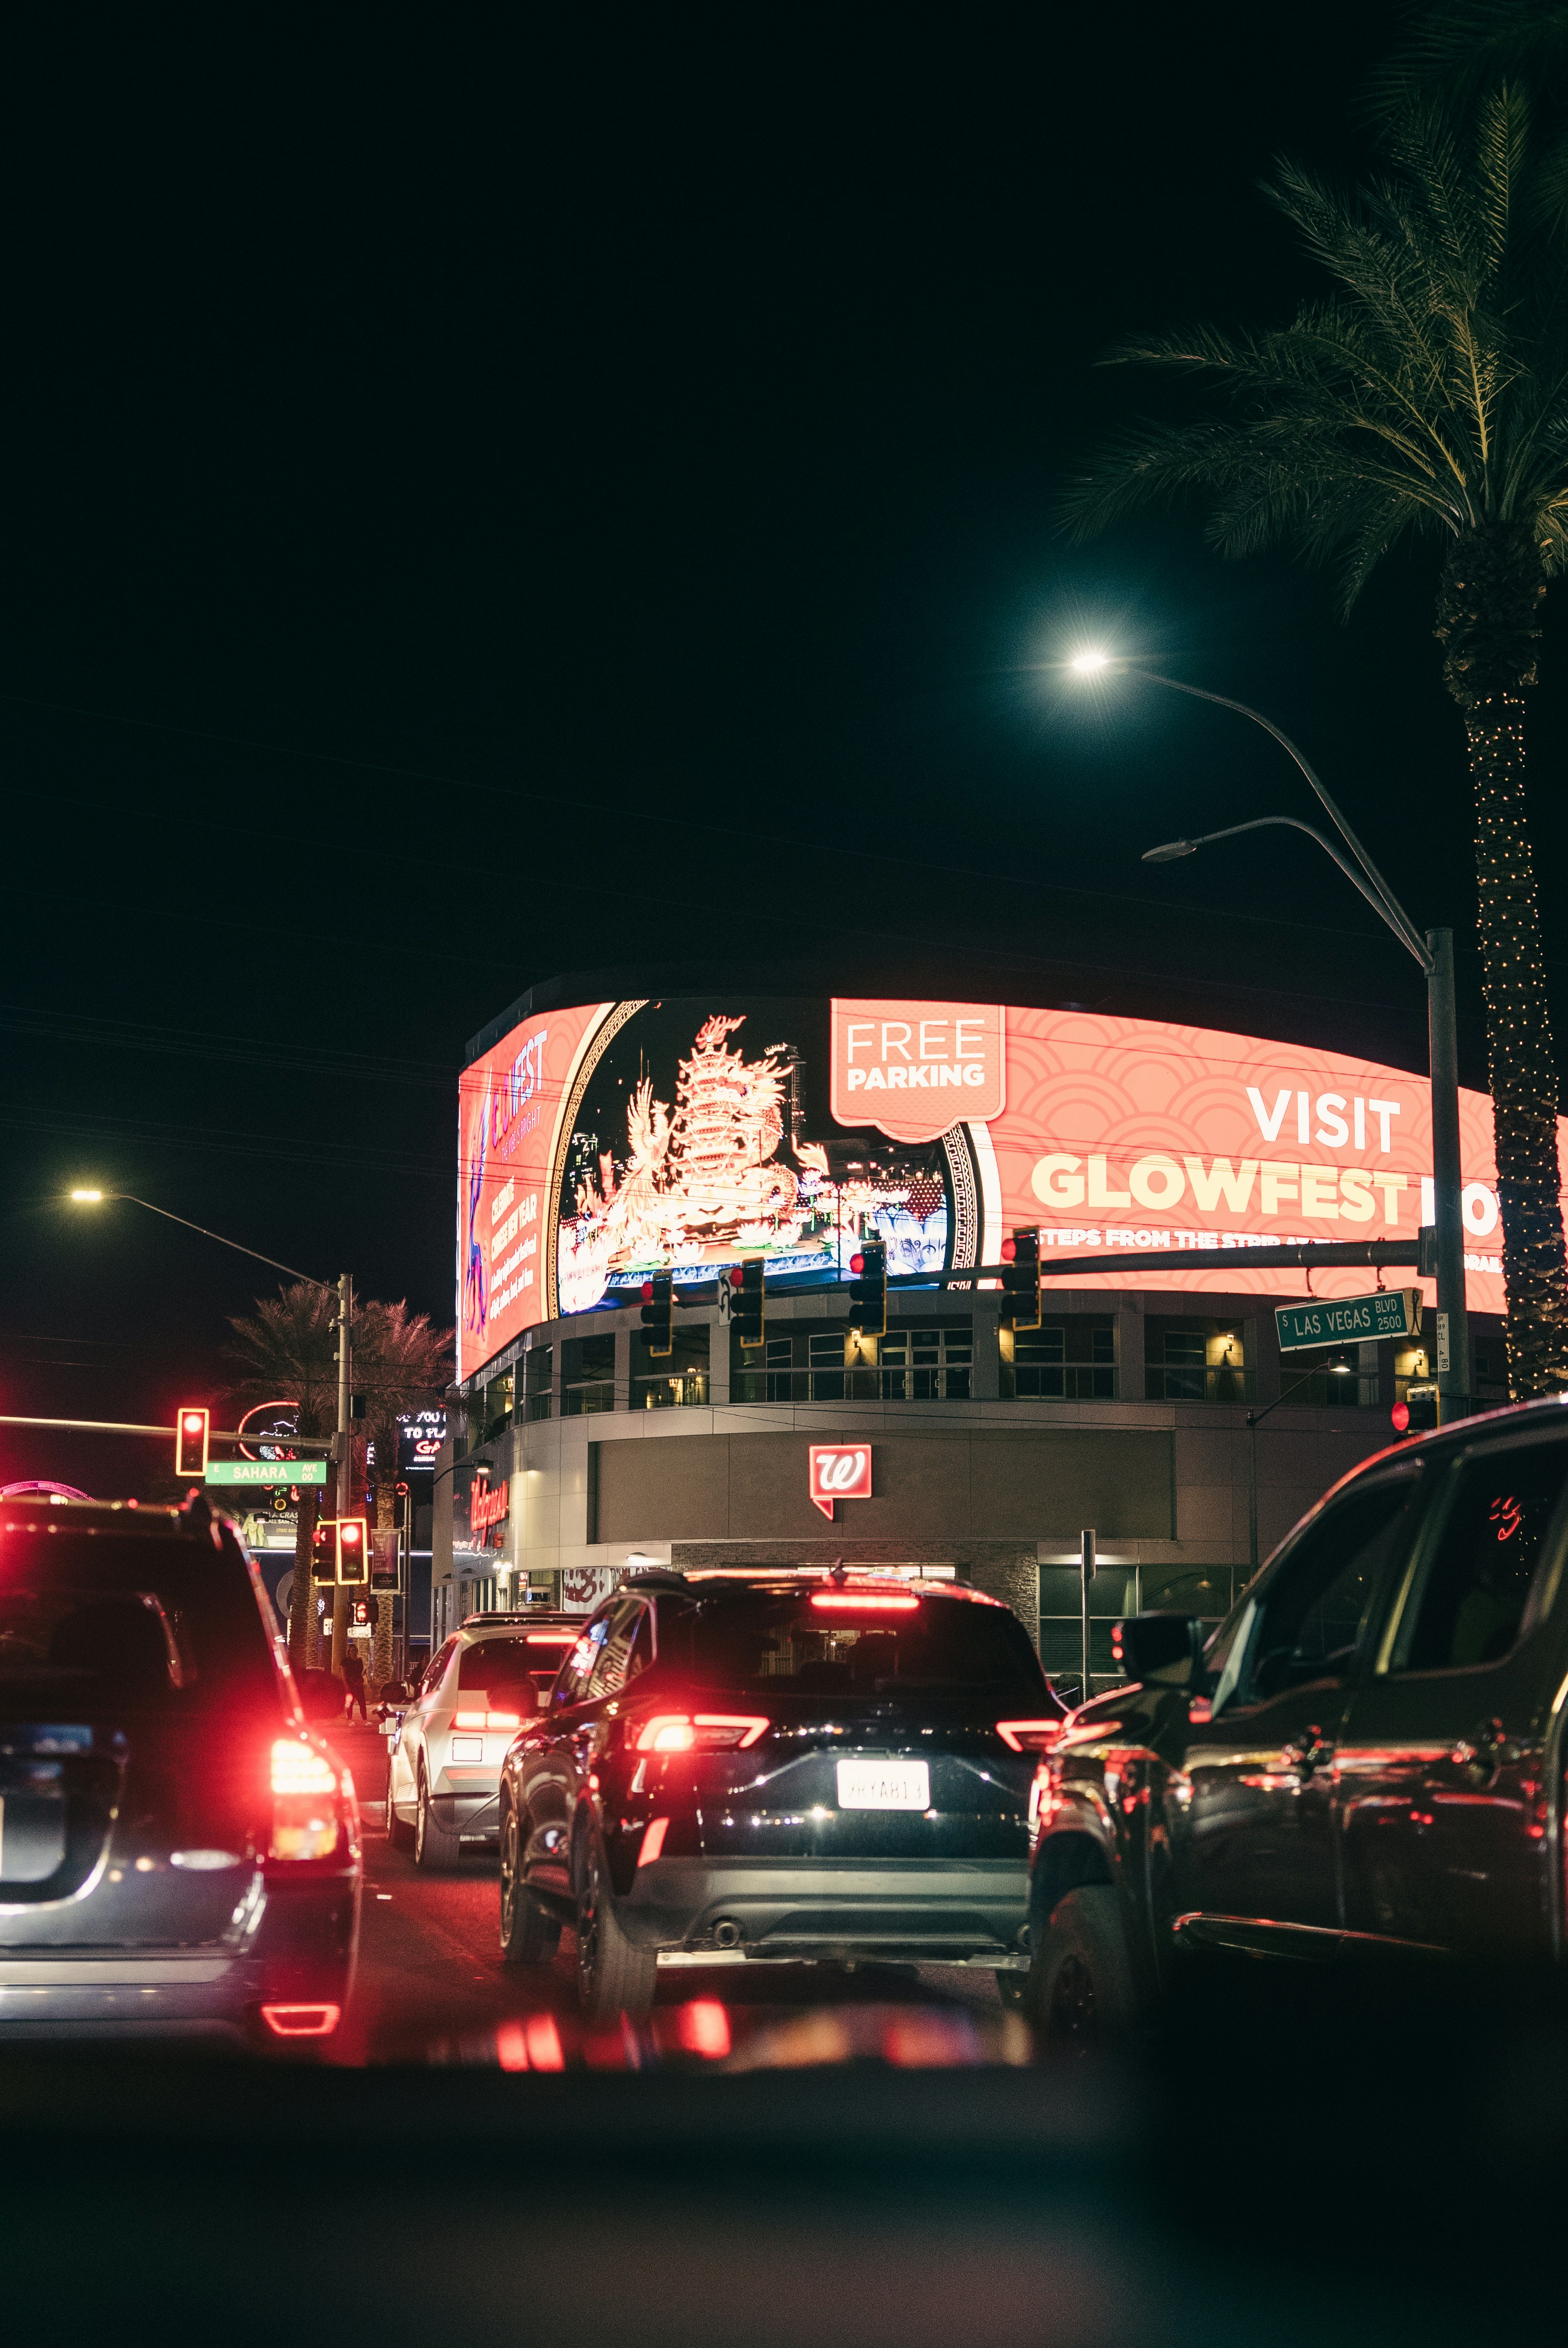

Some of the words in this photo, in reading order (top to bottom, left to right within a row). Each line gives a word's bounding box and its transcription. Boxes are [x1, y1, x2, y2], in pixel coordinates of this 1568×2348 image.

[847, 1019, 985, 1064] FREE
[847, 1063, 985, 1091] PARKING
[520, 1105, 541, 1140] BRIGHT
[1245, 1087, 1401, 1154] VISIT
[1030, 1152, 1408, 1226] GLOWFEST
[519, 1193, 537, 1230] YEAR
[1106, 1229, 1171, 1248] FROM
[1174, 1230, 1219, 1249] THE
[1282, 1314, 1288, 1327] S
[1294, 1314, 1321, 1336] LAS
[1327, 1307, 1371, 1332] VEGAS
[1375, 1299, 1397, 1314] BLVD
[1378, 1315, 1402, 1330] 2500
[404, 1428, 422, 1439] TO
[233, 1466, 287, 1479] SAHARA
[302, 1464, 317, 1472] AVE
[302, 1473, 313, 1481] 00
[816, 1451, 865, 1490] W
